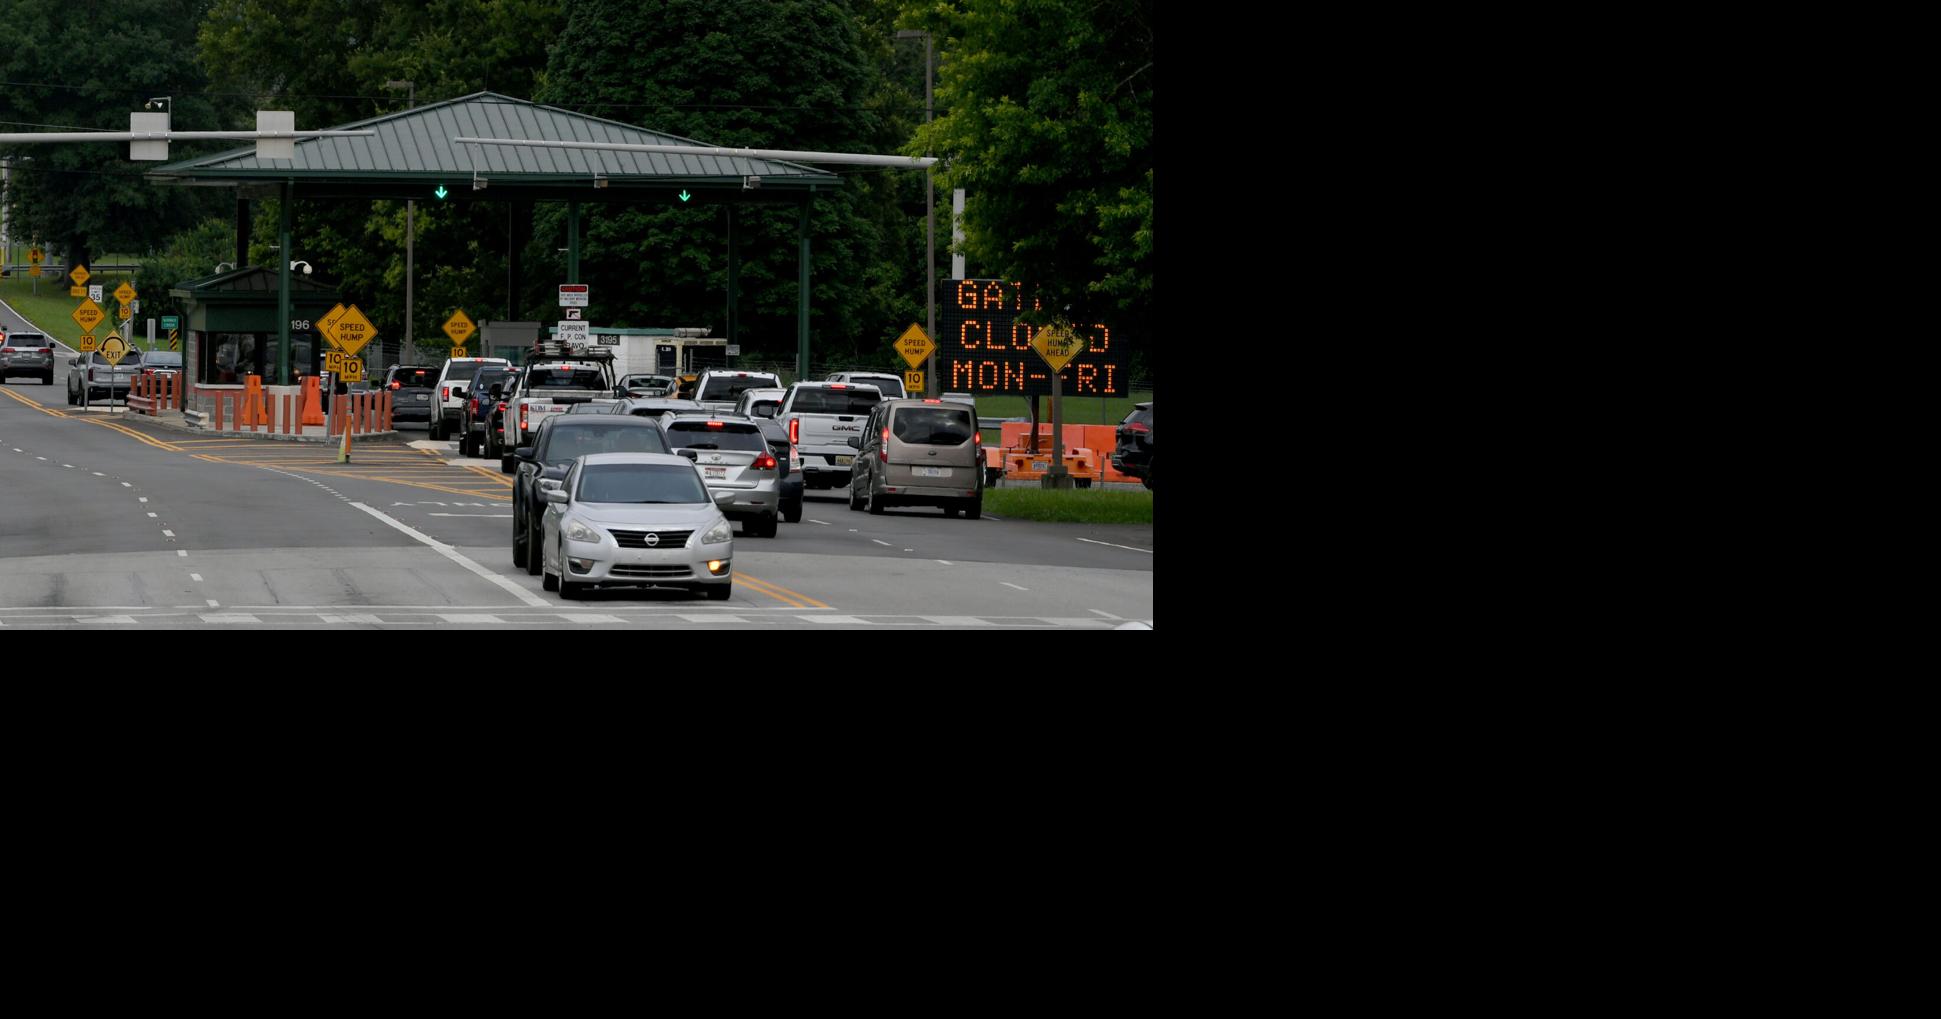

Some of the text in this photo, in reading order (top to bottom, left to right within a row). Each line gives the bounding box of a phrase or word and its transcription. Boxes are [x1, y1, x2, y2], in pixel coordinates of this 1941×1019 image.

[90, 293, 100, 301] 35
[958, 280, 1042, 311] GAT
[291, 320, 310, 330] 196
[339, 323, 365, 332] SPEED
[340, 333, 364, 341] HUMP
[961, 320, 1109, 353] CLOD
[1046, 329, 1069, 337] SPEED
[82, 336, 93, 345] 10
[600, 335, 618, 344] 3195
[904, 338, 926, 346] SPEED
[106, 351, 121, 359] EXIT
[454, 348, 464, 357] 10
[904, 347, 924, 355] HUMP
[1046, 349, 1070, 357] AHEAD
[329, 353, 341, 364] 10
[344, 361, 358, 373] 10
[908, 373, 921, 384] 10
